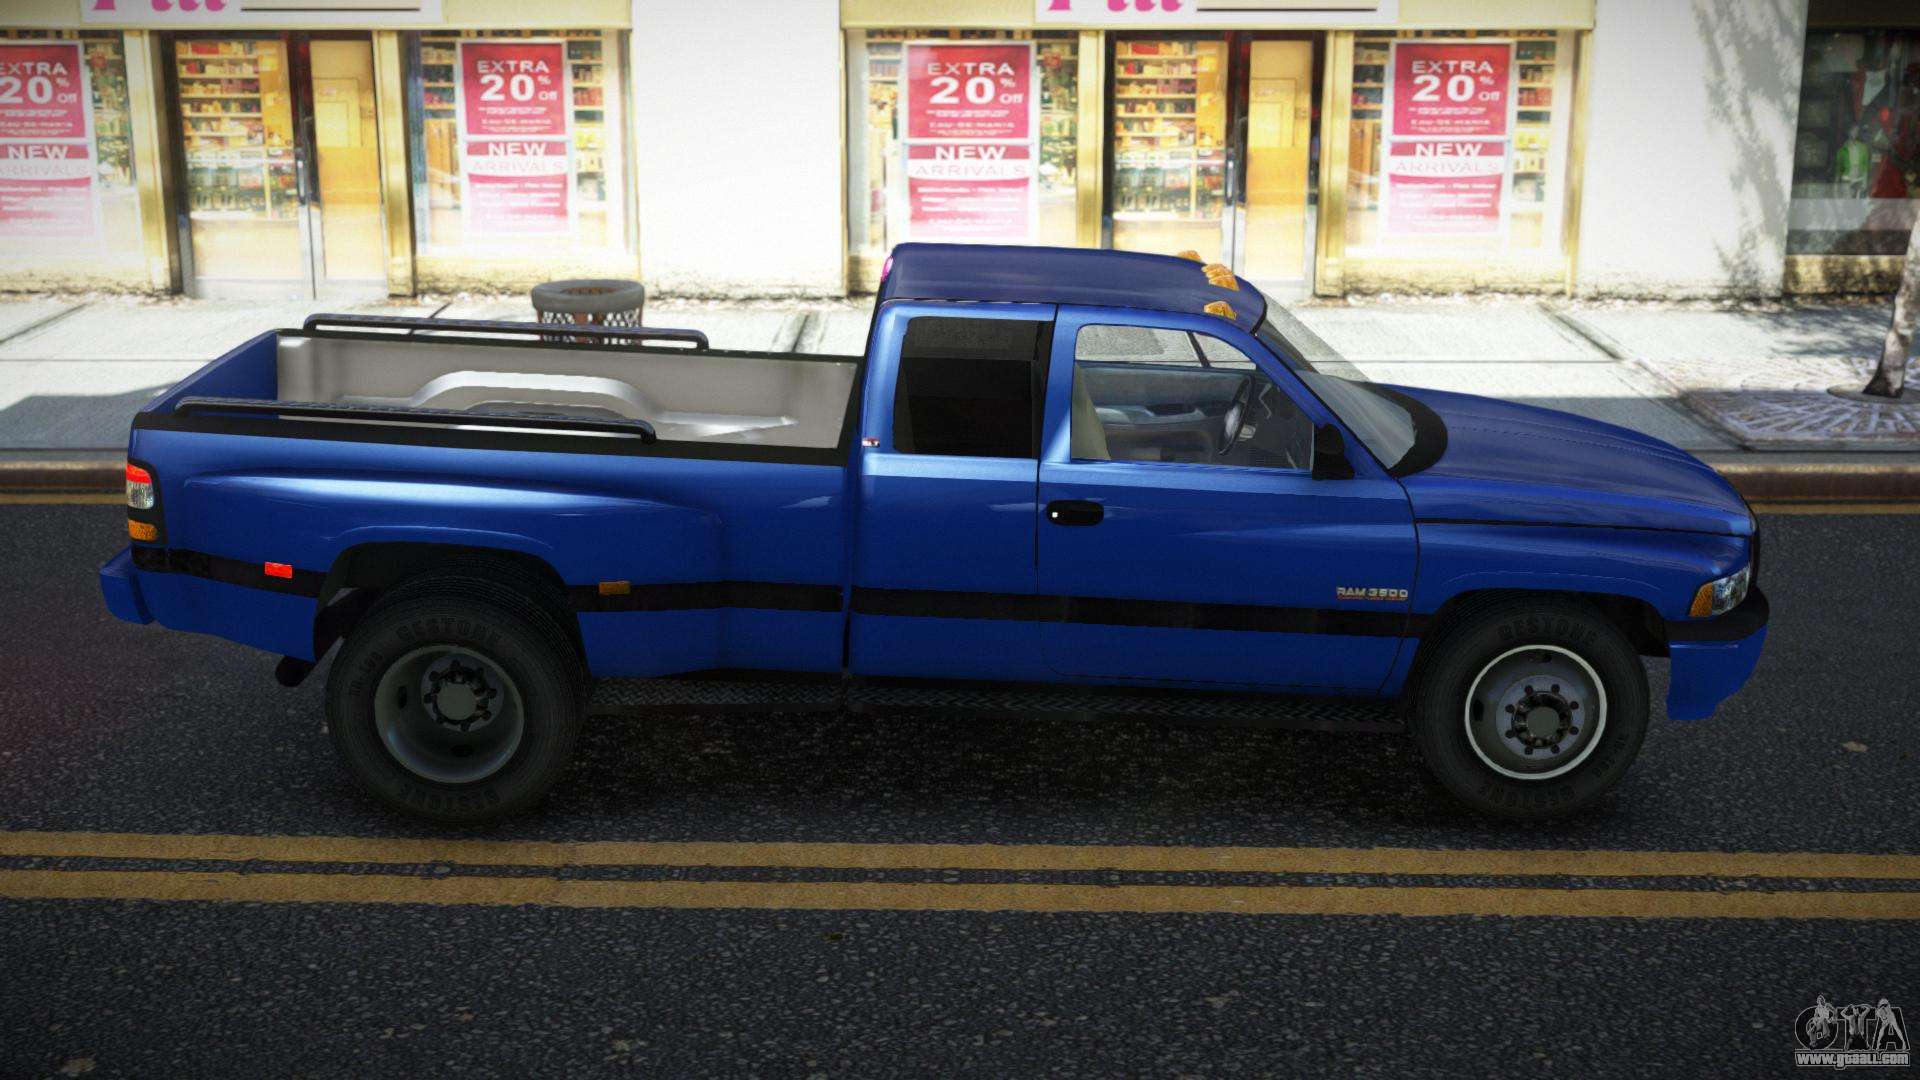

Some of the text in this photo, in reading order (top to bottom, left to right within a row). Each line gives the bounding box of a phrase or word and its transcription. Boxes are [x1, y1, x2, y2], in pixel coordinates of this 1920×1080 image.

[477, 61, 549, 73] EXTRA
[927, 62, 1015, 75] EXTRA
[1412, 61, 1493, 73] EXTRA
[8, 144, 68, 159] NEW
[488, 142, 546, 157] NEW
[935, 146, 1007, 160] NEW
[1414, 143, 1482, 157] NEW
[915, 164, 1027, 176] ARRIVALS
[1336, 587, 1366, 596] RAM
